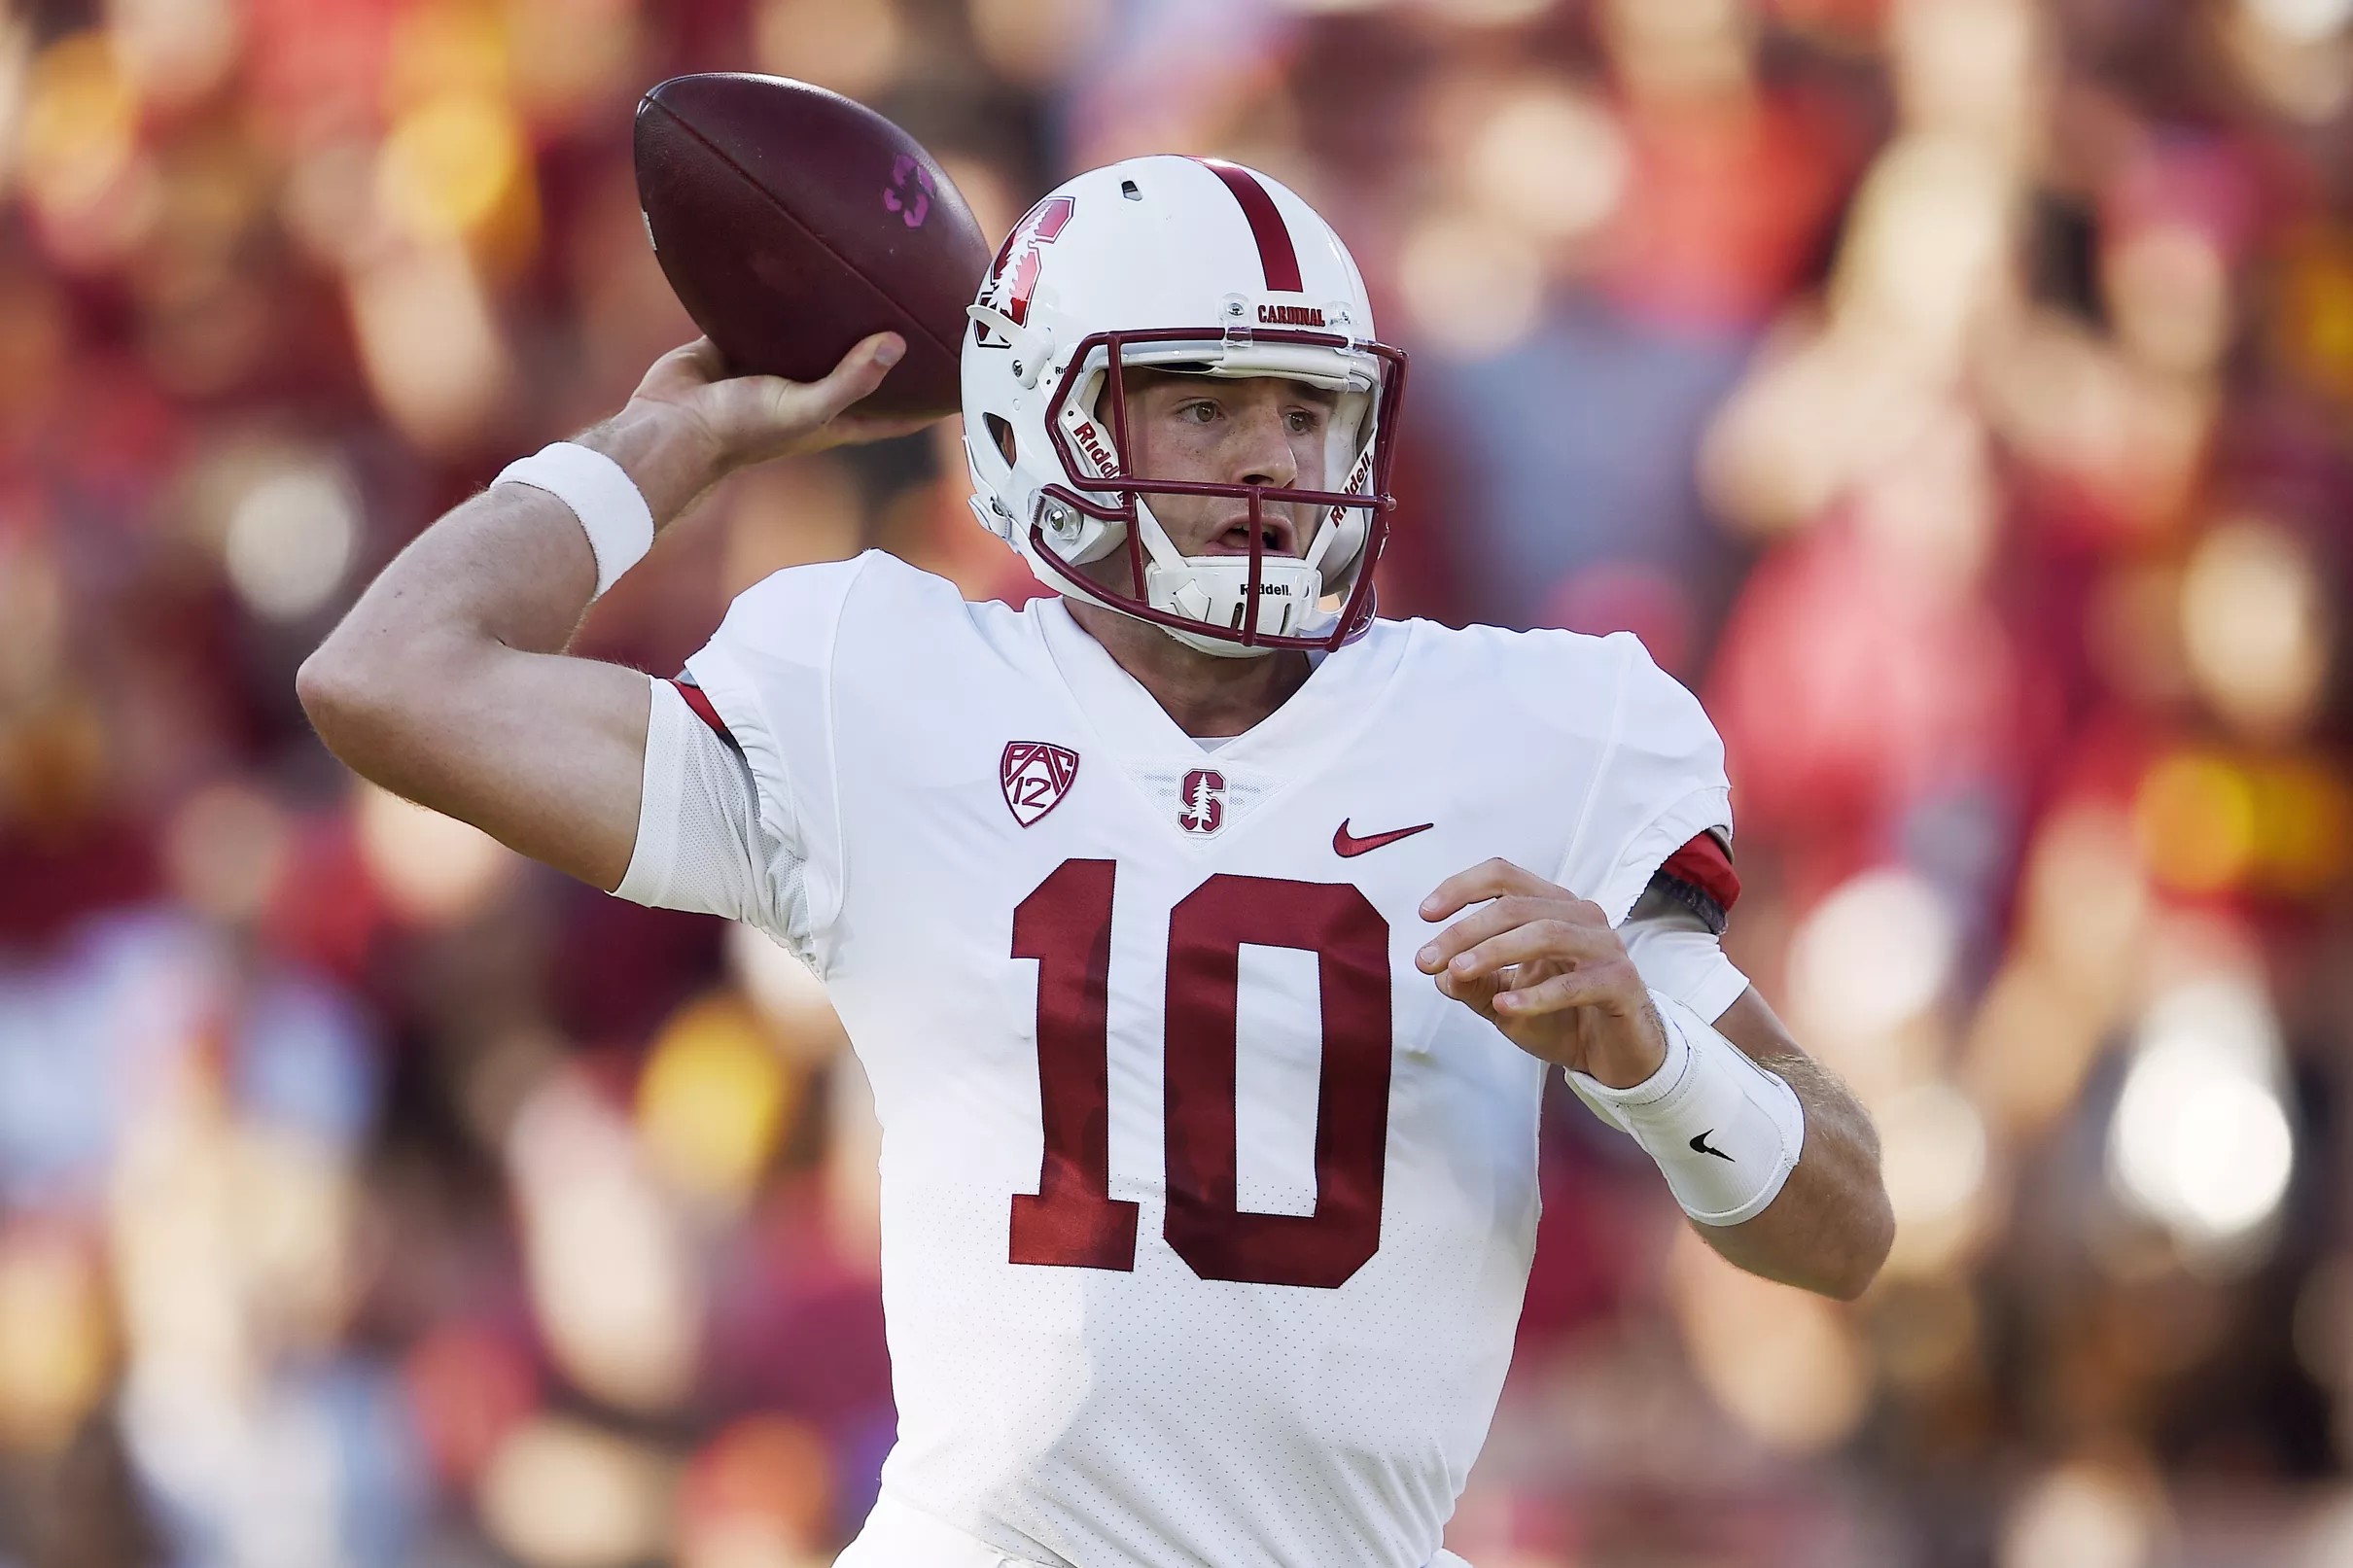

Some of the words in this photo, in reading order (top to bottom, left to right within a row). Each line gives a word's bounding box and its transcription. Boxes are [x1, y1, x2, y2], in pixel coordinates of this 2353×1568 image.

[1257, 304, 1325, 327] CARDINAL
[1240, 583, 1290, 597] Rddell
[1004, 744, 1074, 796] PAC
[1012, 777, 1051, 809] 12
[1008, 857, 1393, 1290] 10
